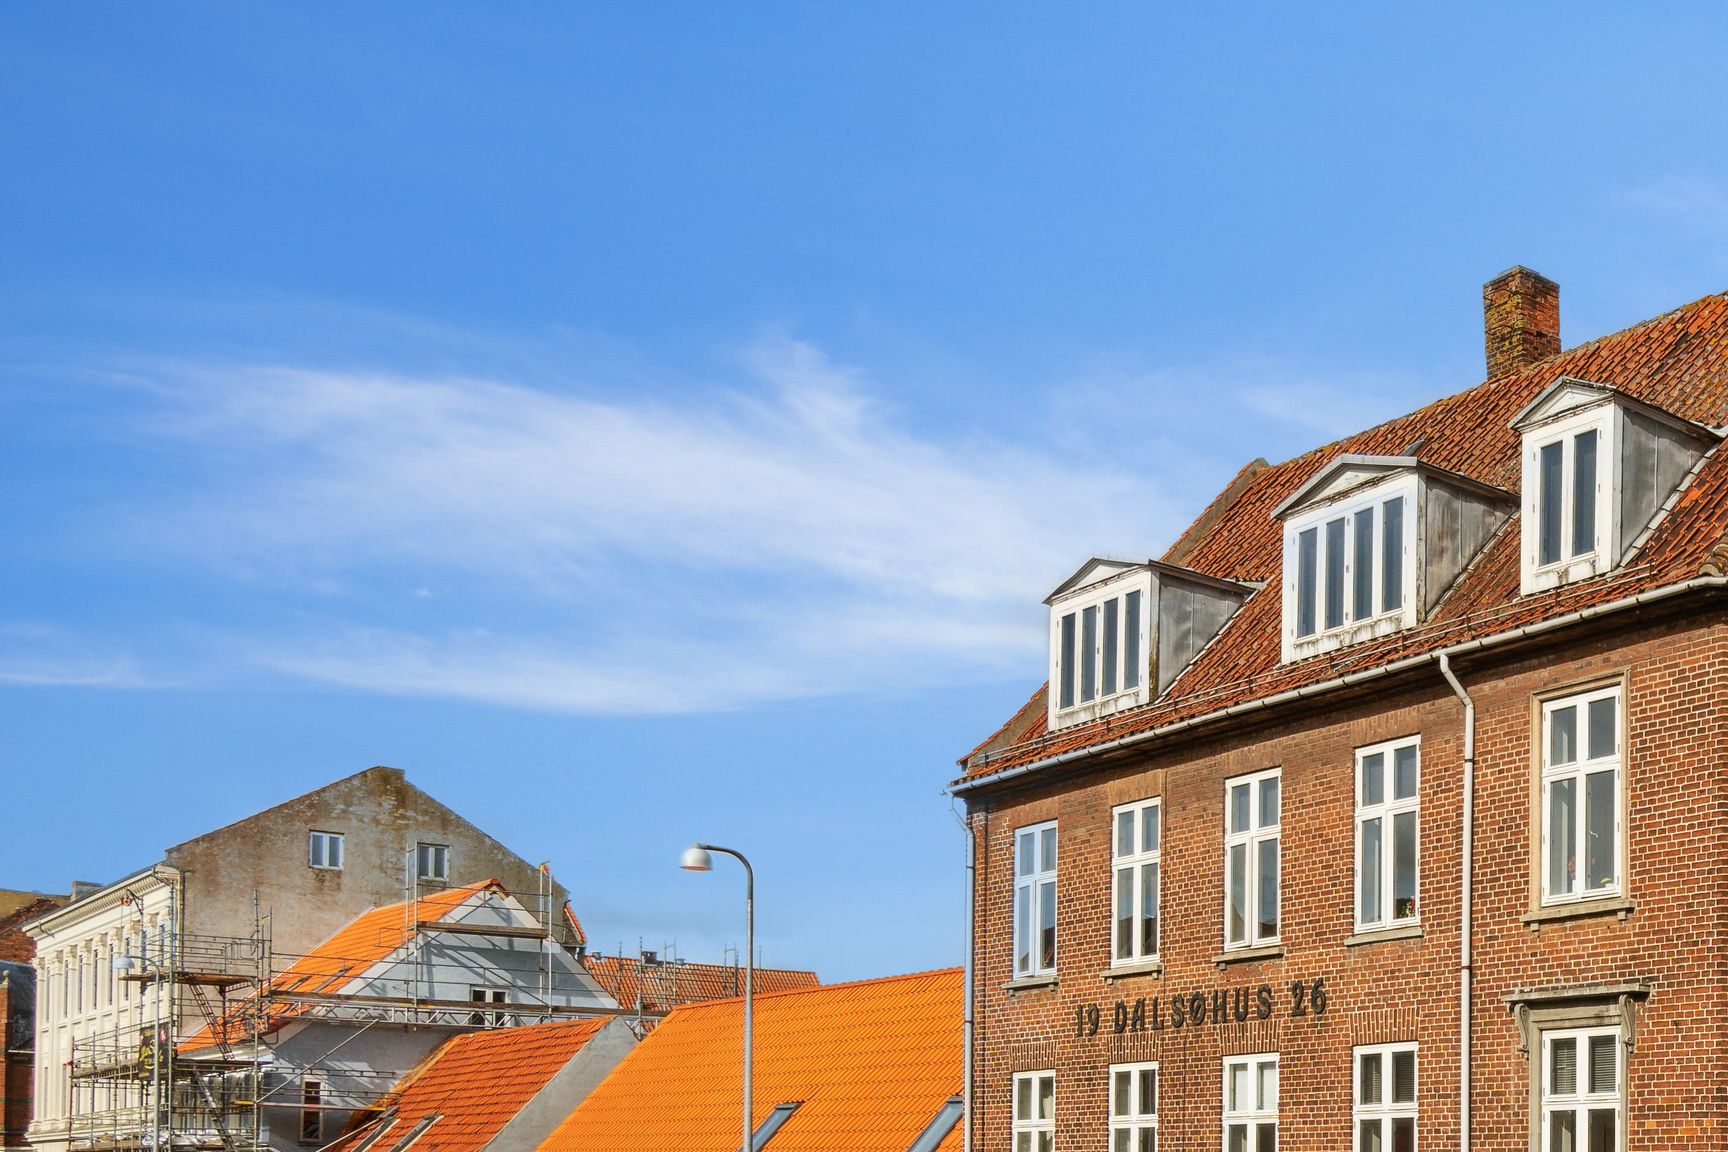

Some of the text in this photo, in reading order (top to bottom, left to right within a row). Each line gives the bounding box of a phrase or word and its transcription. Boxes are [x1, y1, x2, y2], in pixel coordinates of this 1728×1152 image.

[1076, 978, 1327, 1038] 19 DALSØHUS 26
